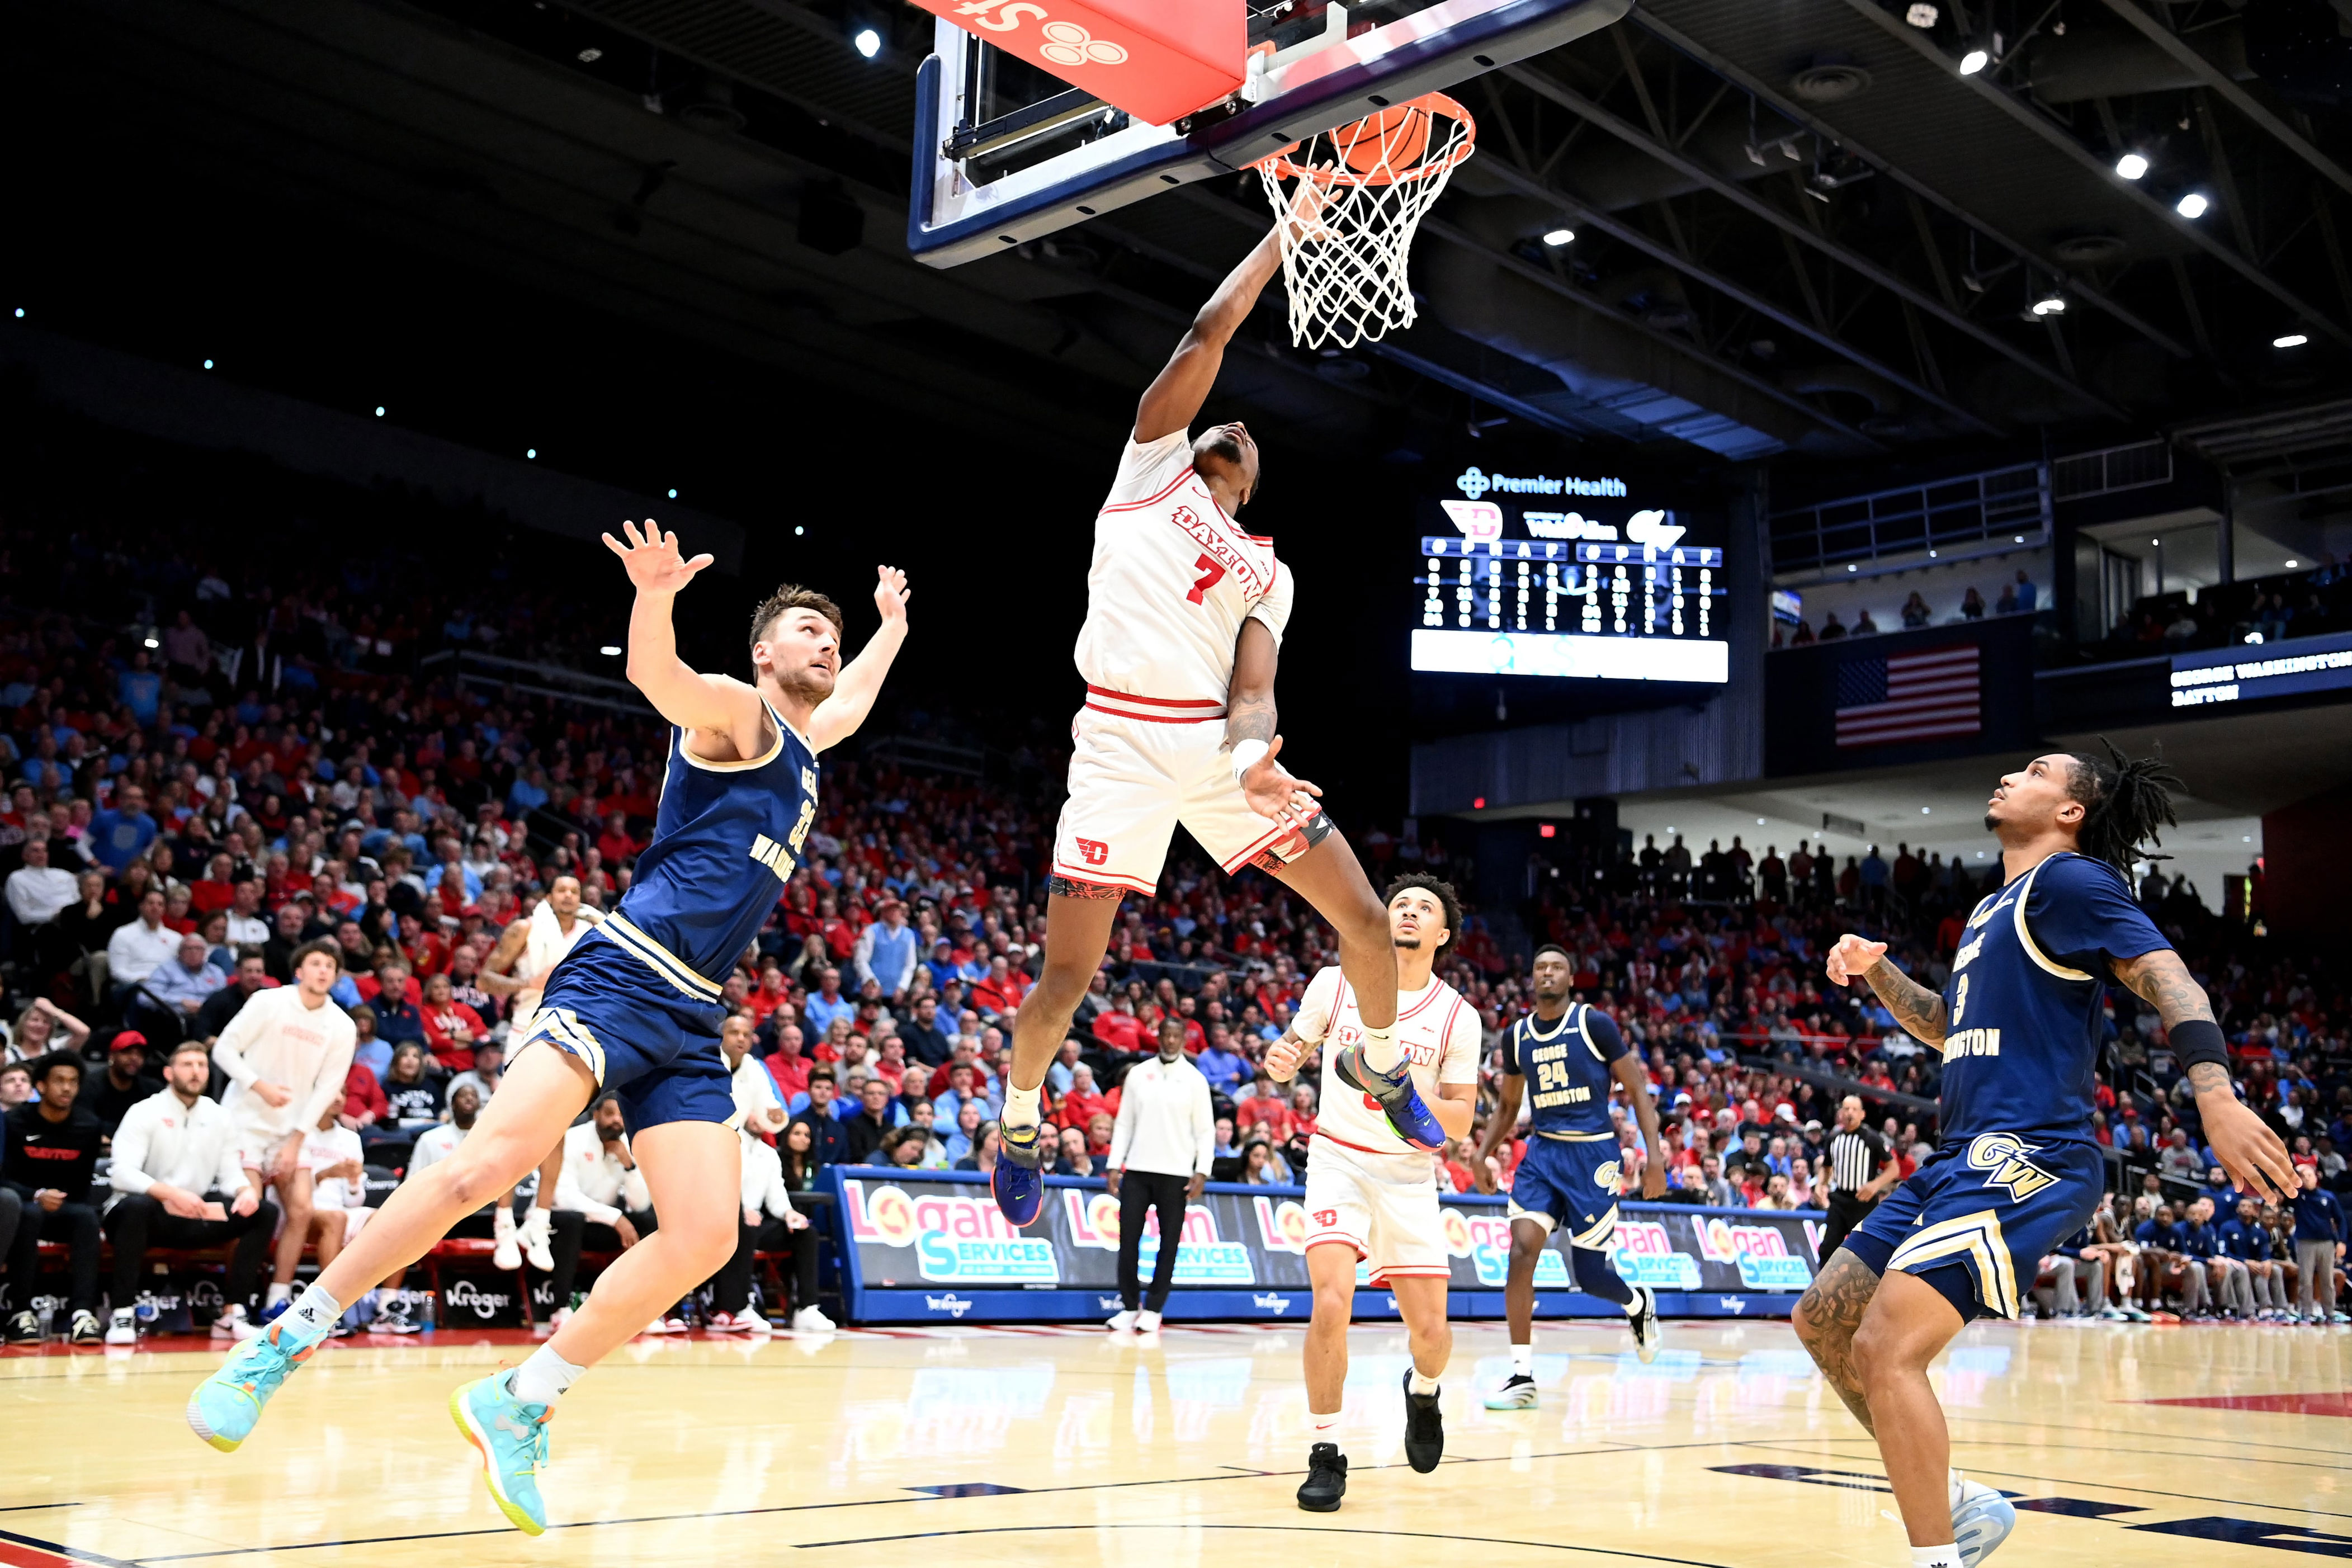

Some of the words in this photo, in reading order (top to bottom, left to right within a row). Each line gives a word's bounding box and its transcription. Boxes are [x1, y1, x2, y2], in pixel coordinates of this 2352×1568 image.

[1492, 474, 1564, 494] Premier
[1565, 476, 1627, 497] Health
[1171, 505, 1262, 602] DAYTON
[1186, 552, 1226, 606] 7
[2171, 665, 2234, 687] GEORGE
[2236, 651, 2352, 679] WASHINGTON
[2171, 684, 2239, 706] DAYTON
[1953, 972, 1969, 1027] 3
[1532, 1043, 1567, 1063] GEORGE
[1537, 1060, 1569, 1091] 24
[1967, 1132, 2062, 1203] GW
[1696, 1221, 1789, 1257] Logan
[446, 1281, 511, 1319] Kroger
